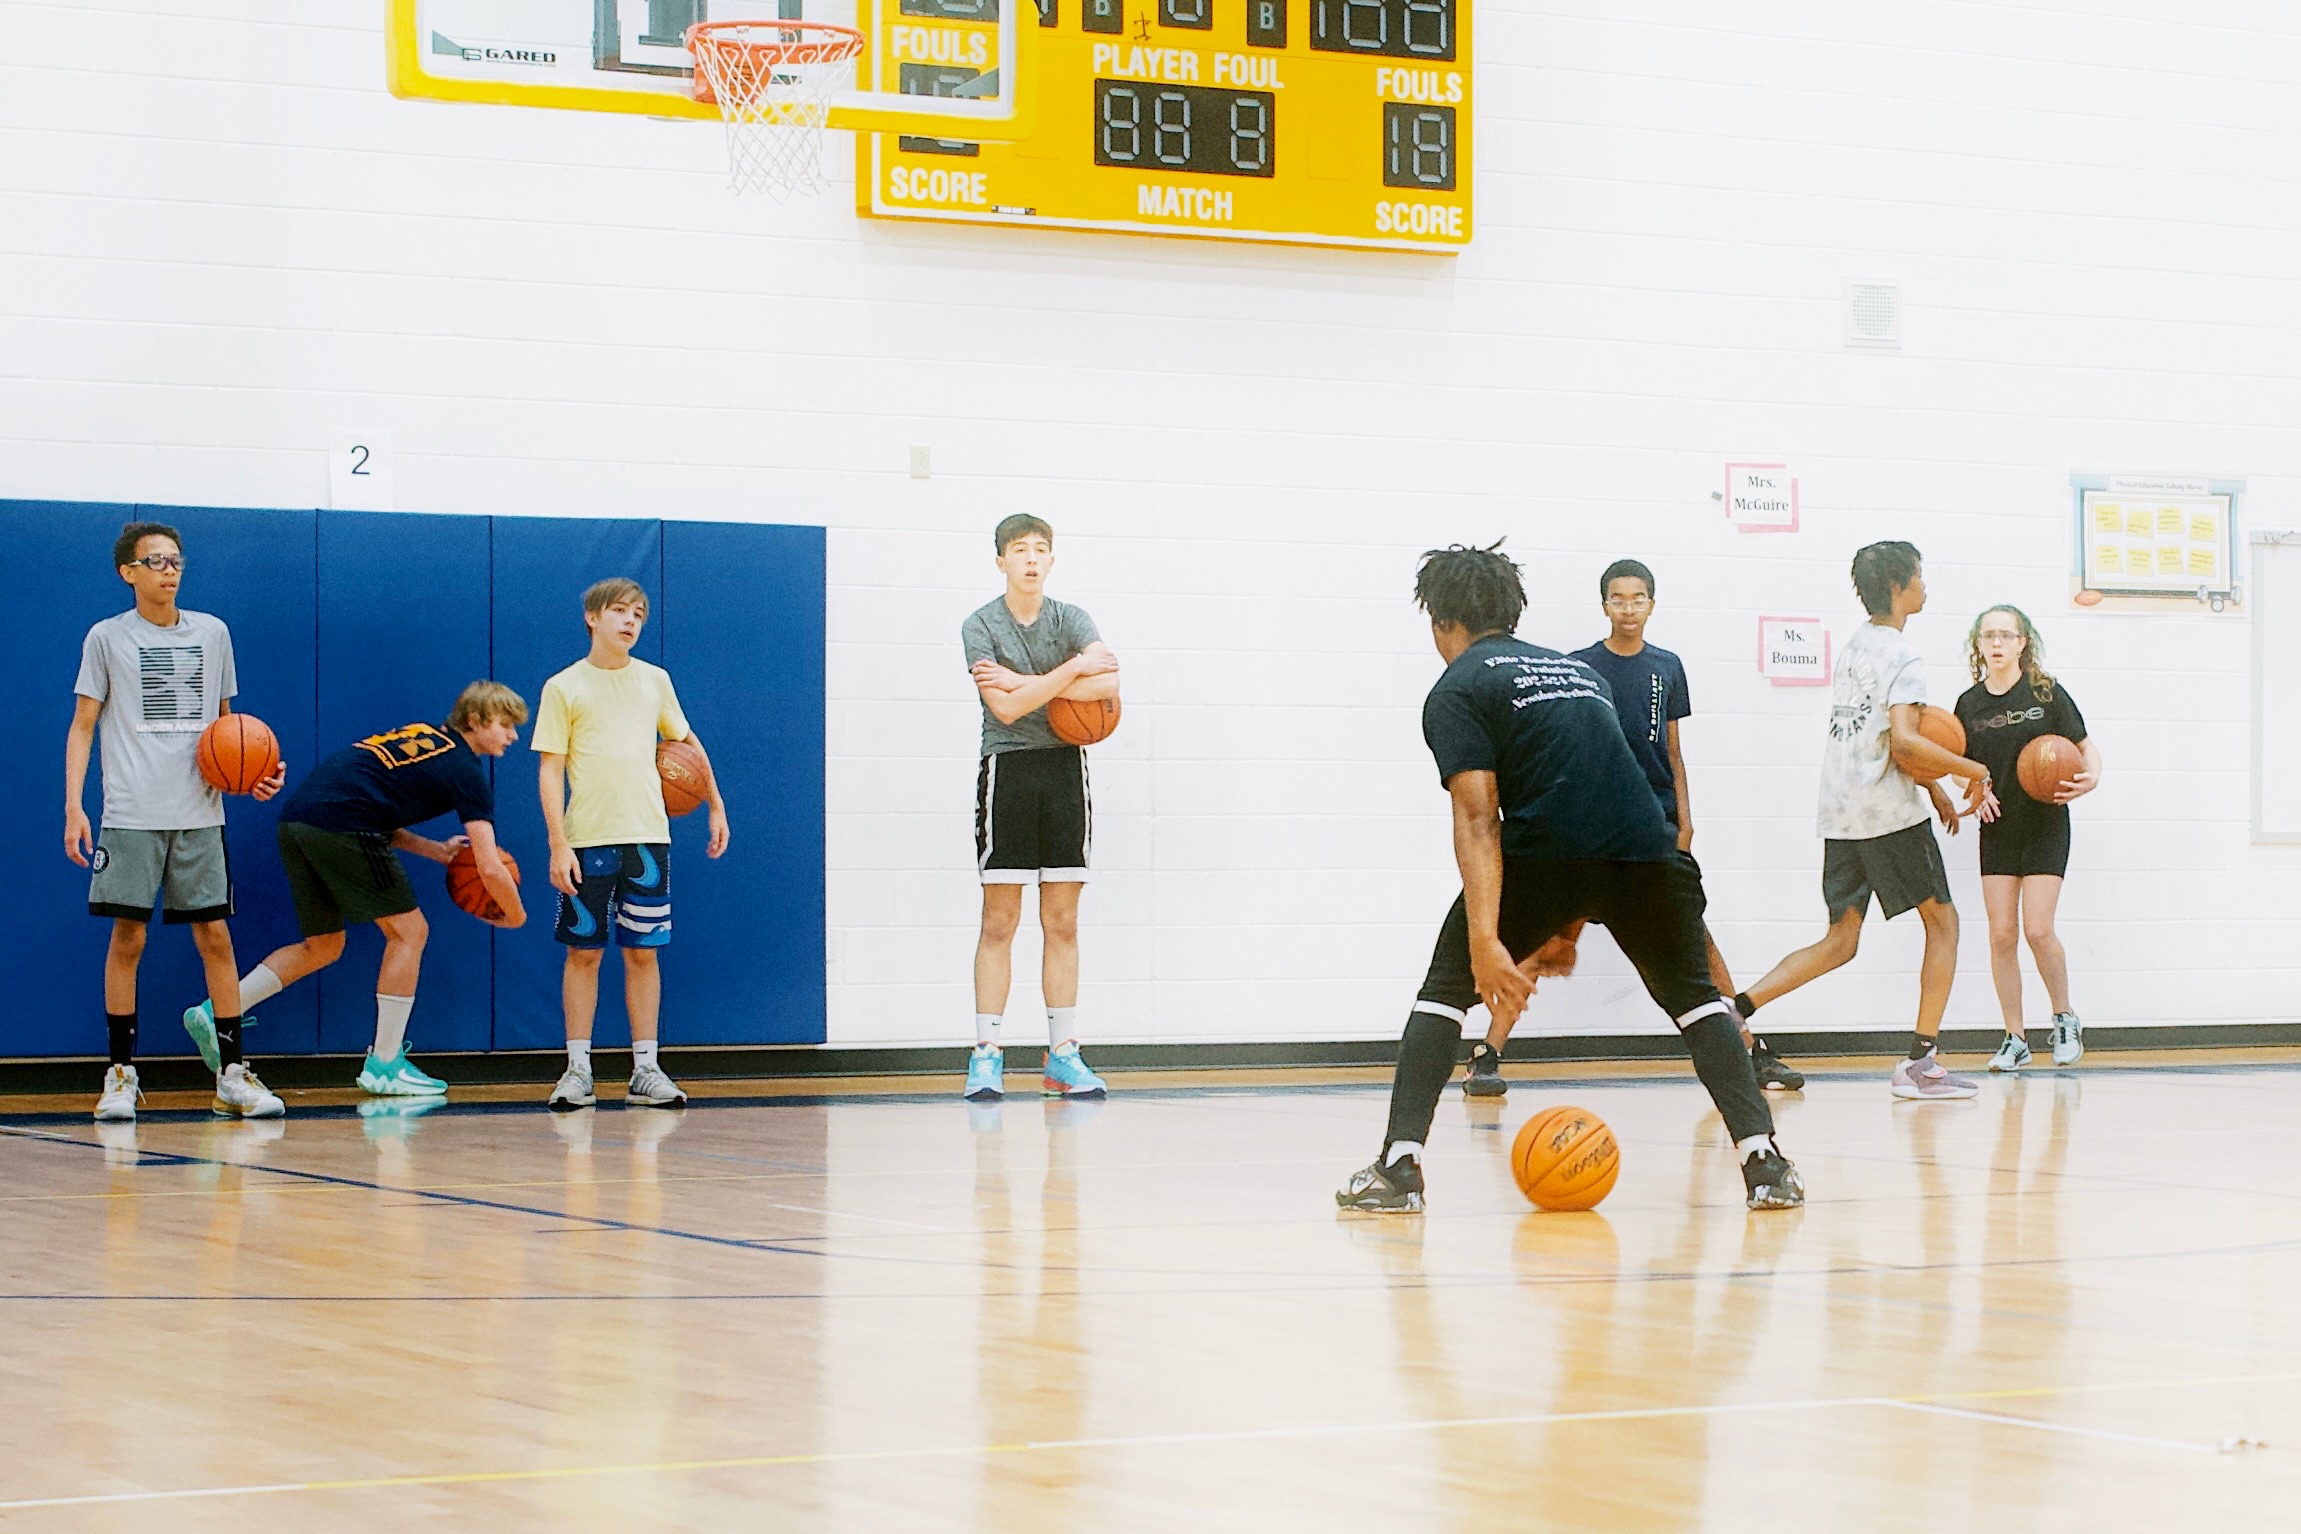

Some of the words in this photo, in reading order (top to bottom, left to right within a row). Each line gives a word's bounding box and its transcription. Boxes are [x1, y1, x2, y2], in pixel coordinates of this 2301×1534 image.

[486, 48, 556, 62] GARED
[892, 26, 987, 65] FOULS
[1093, 43, 1199, 81] PLAYER
[1214, 52, 1285, 89] FOUL
[1376, 68, 1463, 103] FOULS
[890, 166, 987, 204] SCORE
[1137, 184, 1233, 221] MATCH
[1375, 201, 1463, 237] SCORE
[351, 445, 370, 475] 2
[1748, 475, 1776, 488] Mrs.
[1734, 498, 1790, 512] McGuire
[1783, 629, 1806, 643] Ms.
[1771, 651, 1818, 665] Bouma
